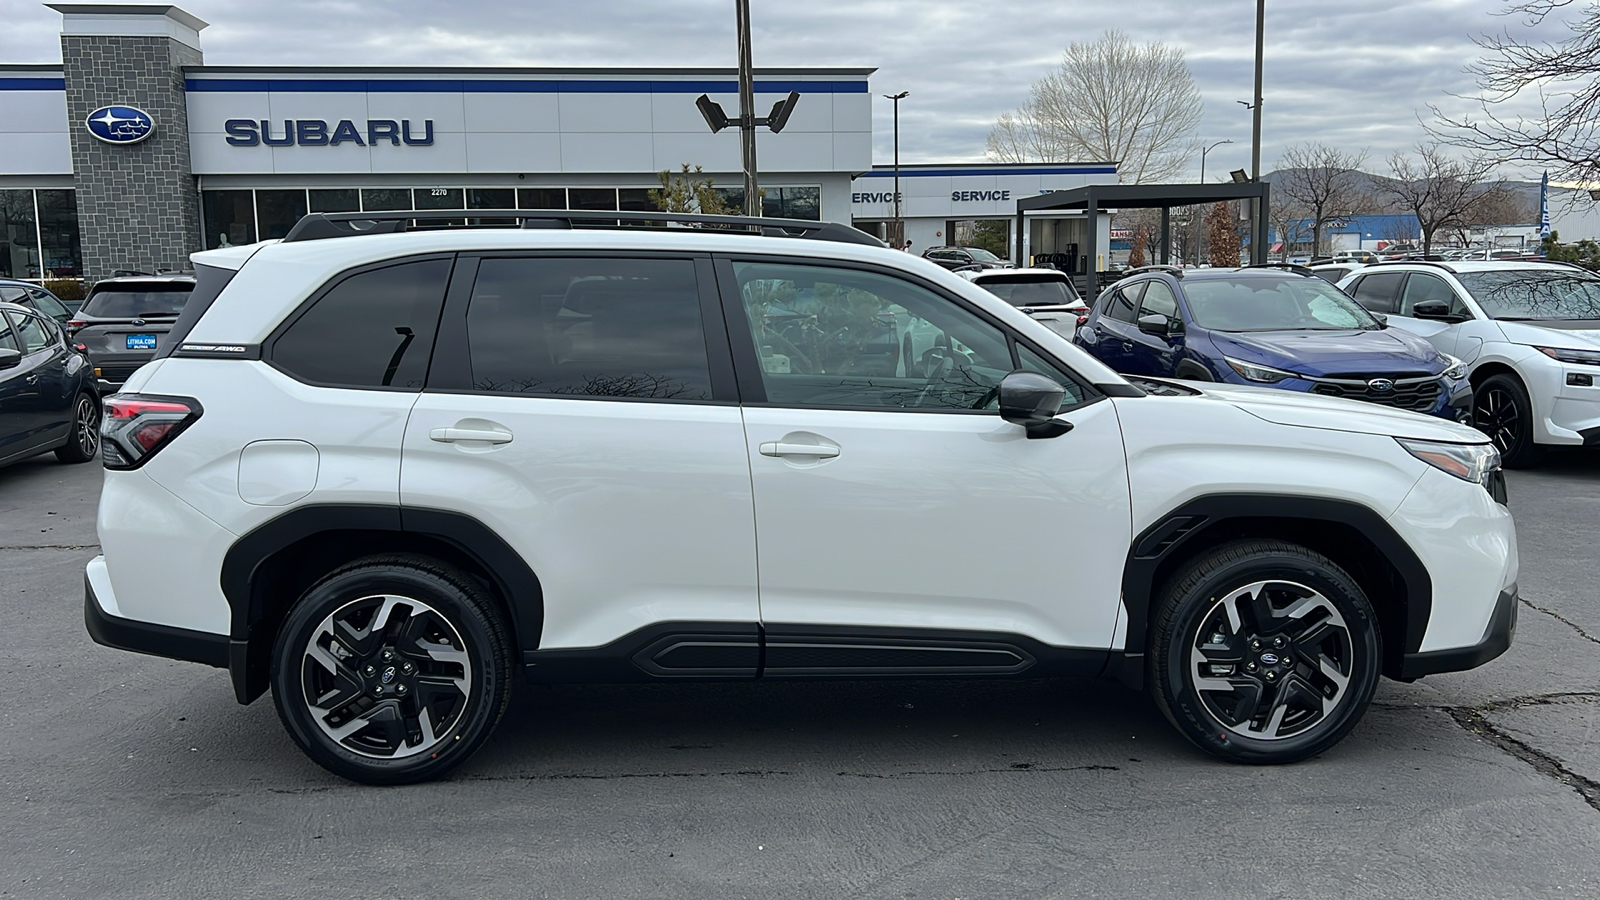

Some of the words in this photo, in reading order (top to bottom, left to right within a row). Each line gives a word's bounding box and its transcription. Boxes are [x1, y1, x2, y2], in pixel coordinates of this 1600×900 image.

[225, 119, 434, 146] SUBARU
[431, 188, 448, 196] 2270
[851, 192, 902, 203] ERVICE
[951, 190, 1010, 202] SERVICE
